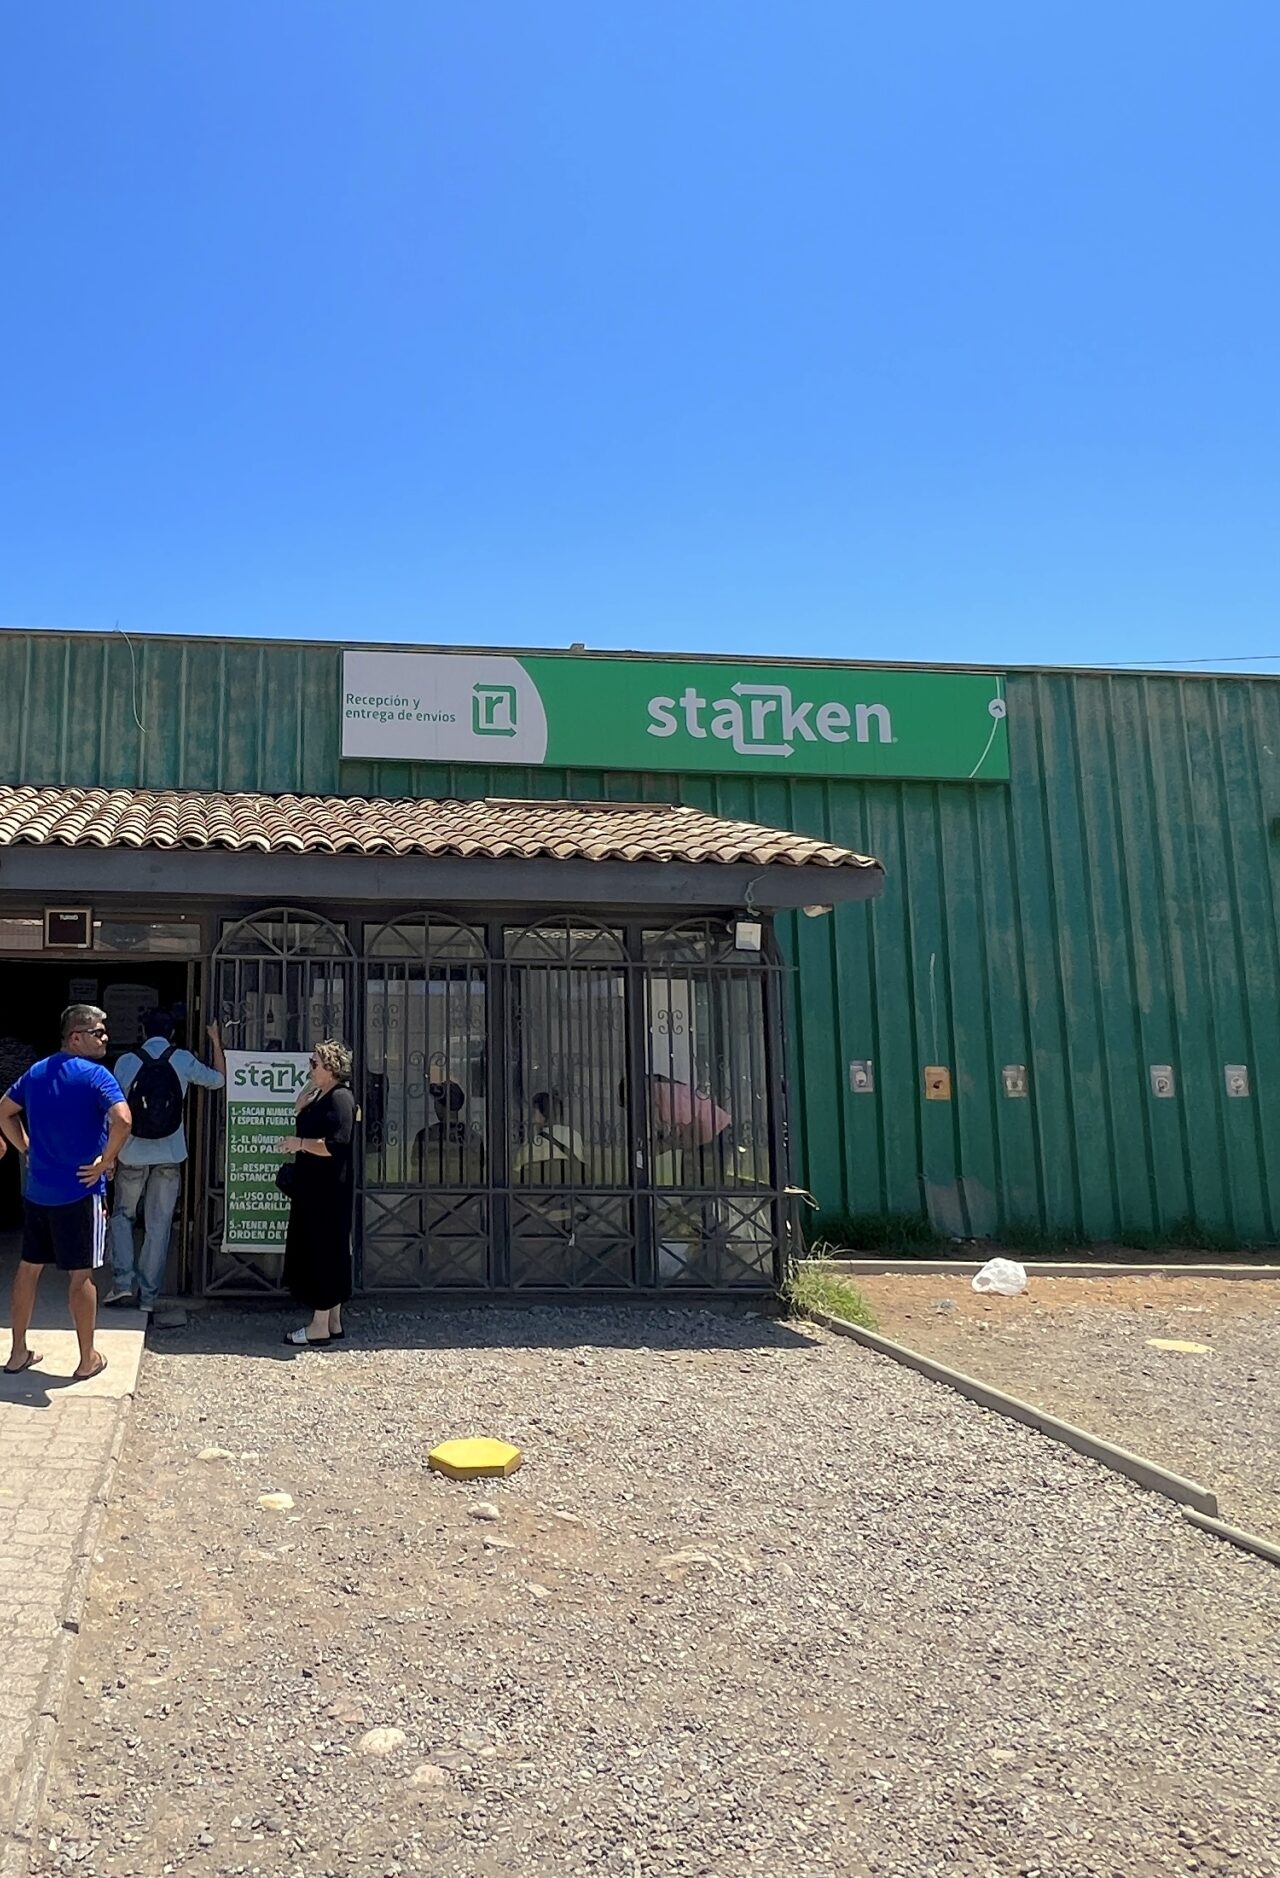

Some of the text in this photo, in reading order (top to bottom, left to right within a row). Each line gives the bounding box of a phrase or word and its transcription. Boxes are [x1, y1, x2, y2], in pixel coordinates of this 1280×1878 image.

[346, 693, 420, 710] Recepción y
[346, 709, 394, 723] entrega
[397, 709, 413, 721] de
[646, 682, 893, 758] starken
[231, 1116, 237, 1125] Y
[237, 1116, 265, 1125] ESPERA
[266, 1116, 289, 1125] FUERA
[230, 1144, 258, 1153] SOLO
[230, 1173, 277, 1182] DISTANCIA
[229, 1201, 291, 1211] MASCARILLA
[269, 1220, 276, 1230] A
[229, 1230, 265, 1239] ORDEN
[267, 1231, 282, 1239] DE
